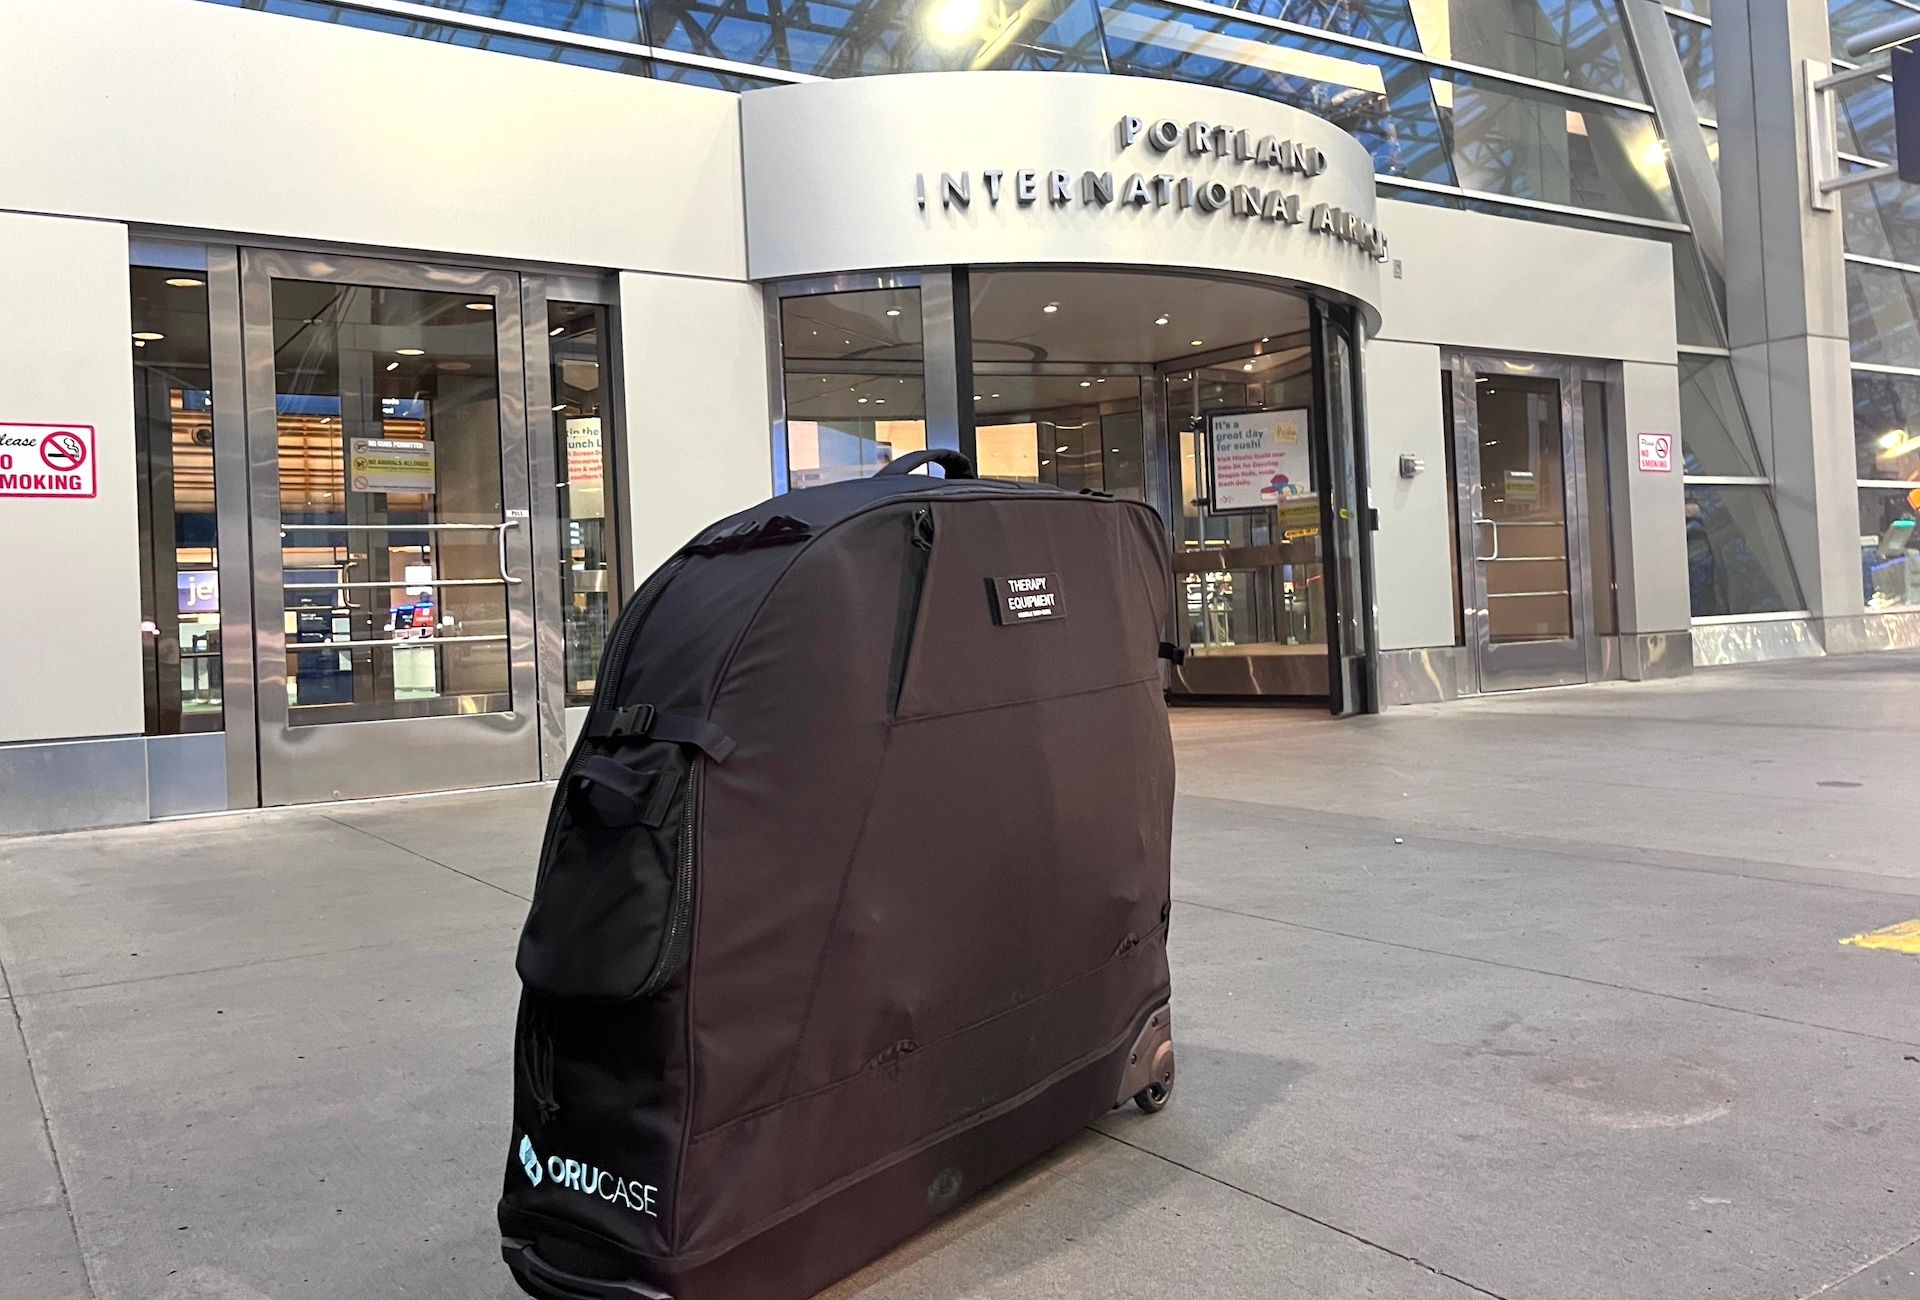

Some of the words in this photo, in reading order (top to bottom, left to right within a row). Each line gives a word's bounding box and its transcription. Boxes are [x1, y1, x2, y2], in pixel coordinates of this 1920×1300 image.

[1121, 115, 1328, 177] PORTLAND
[915, 170, 1304, 225] INTERNATIONAL
[582, 427, 599, 436] the
[1216, 431, 1243, 442] great
[1245, 428, 1264, 439] day
[0, 433, 37, 447] lease
[568, 438, 594, 449] unch
[1216, 442, 1230, 452] for
[1234, 441, 1261, 450] sushi
[0, 454, 13, 470] O
[0, 474, 82, 490] MOKING
[187, 576, 218, 606] je
[1007, 577, 1046, 593] THERAPY
[1007, 593, 1055, 610] EQUIPMENT
[547, 1155, 658, 1218] ORUCASE
